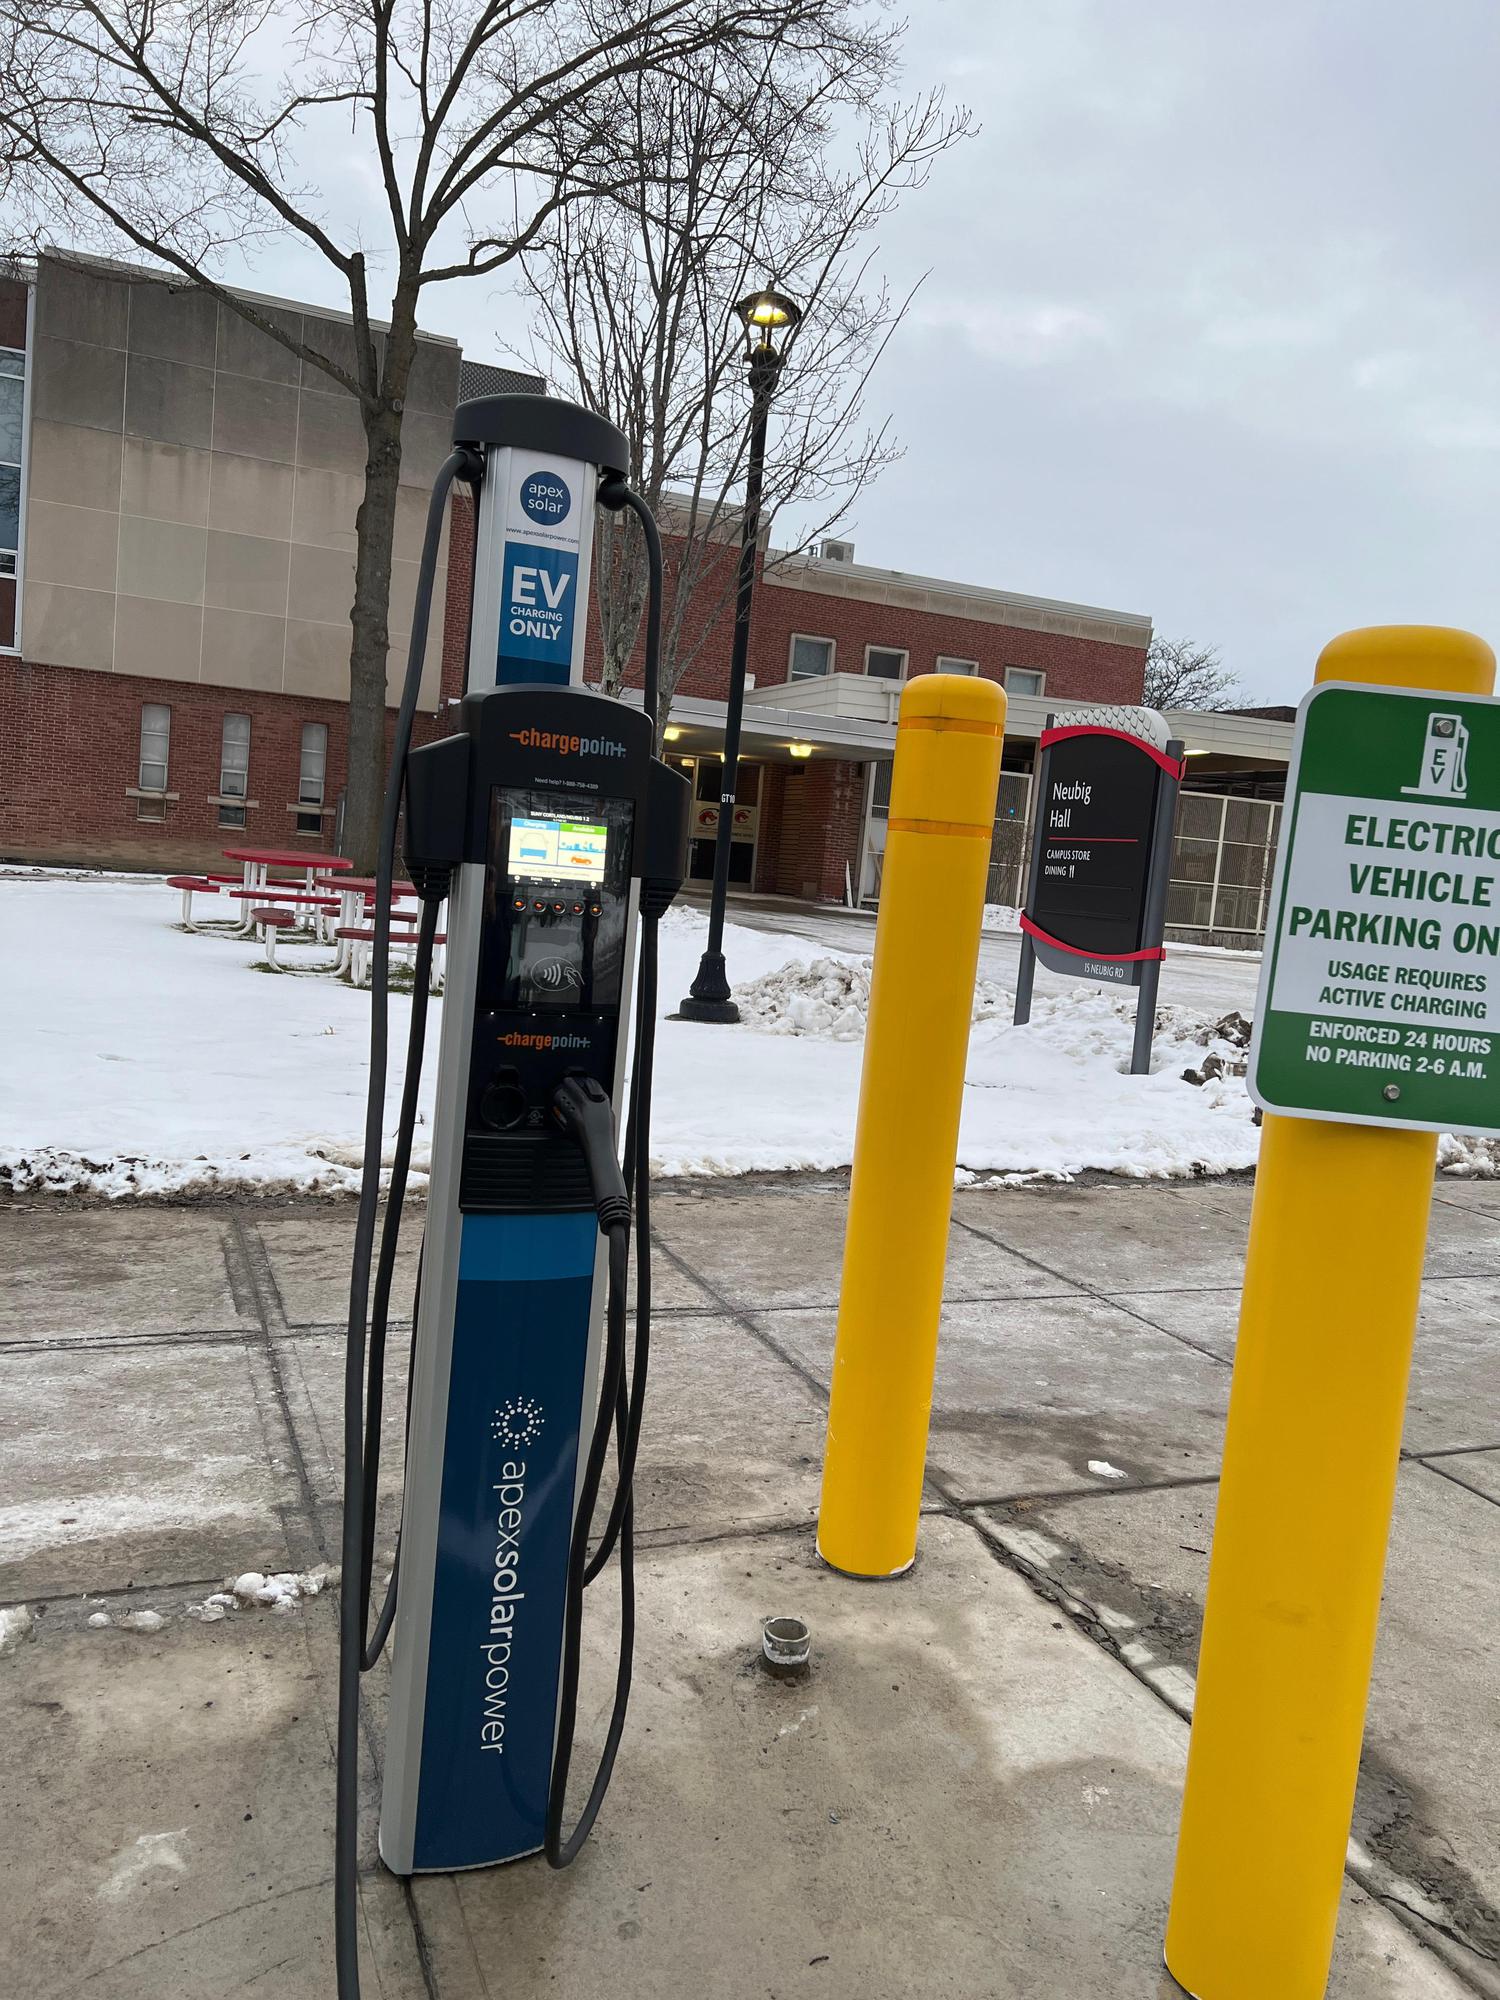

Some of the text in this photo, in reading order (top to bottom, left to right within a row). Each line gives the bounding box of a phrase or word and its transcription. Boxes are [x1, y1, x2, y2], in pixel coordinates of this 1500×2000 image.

[528, 482, 564, 502] apex
[528, 496, 562, 514] solar
[512, 566, 570, 609] EV
[510, 606, 563, 621] CHARGING
[510, 619, 562, 640] ONLY
[520, 728, 626, 758] chargepoint
[549, 778, 561, 786] help?
[1052, 780, 1092, 805] Neubig
[1050, 808, 1070, 828] Hall
[1047, 849, 1090, 860] CAMPUS STORE
[1045, 865, 1066, 876] DINING
[1350, 863, 1494, 907] VEHICLE
[1288, 906, 1441, 950] PARKING
[1091, 964, 1114, 976] NEUBIG
[1115, 968, 1124, 978] RD
[1328, 960, 1487, 992] USAGE REQUIRES
[1319, 986, 1487, 1019] ACTIVE CHARGING
[504, 1032, 590, 1049] chargepoint
[1309, 1020, 1491, 1055] ENFORCED 24 HOURS
[1306, 1045, 1487, 1079] NO PARKING 2-6 A.M.
[480, 1460, 525, 1754] apexsolarpower
